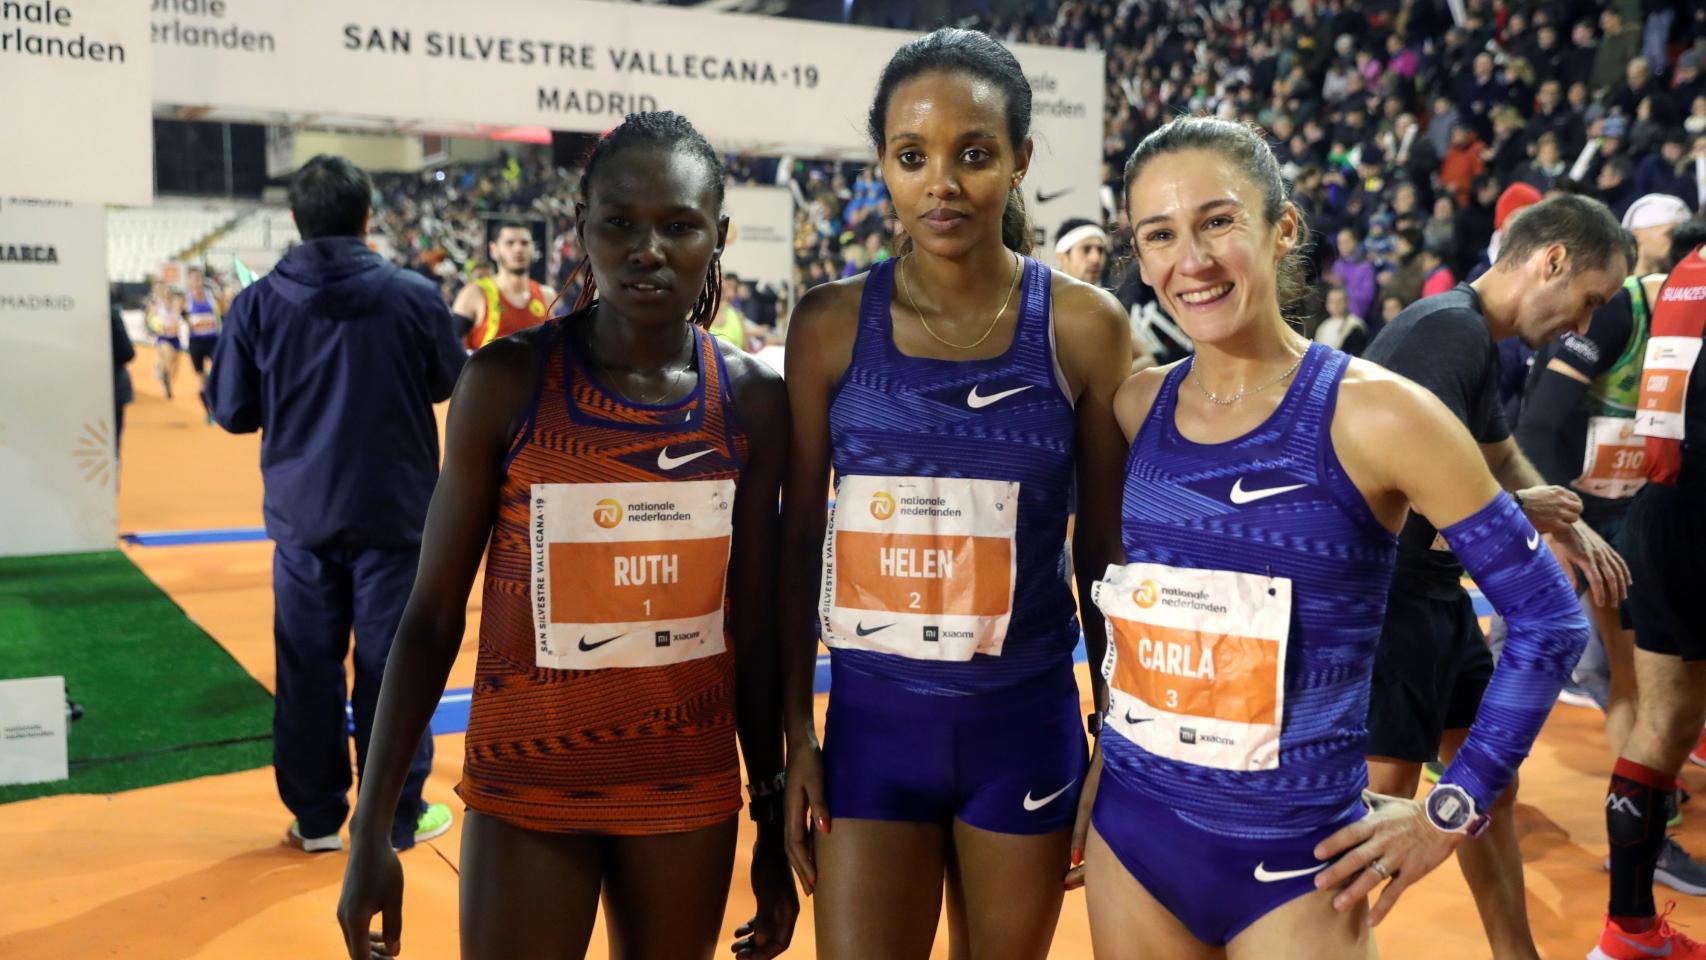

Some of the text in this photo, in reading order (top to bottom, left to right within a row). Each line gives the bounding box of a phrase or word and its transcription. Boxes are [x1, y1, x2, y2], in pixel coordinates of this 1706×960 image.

[343, 25, 411, 54] SAN
[426, 33, 597, 70] SILVESTRE
[537, 88, 658, 115] MADRID
[0, 245, 58, 263] ARCA
[628, 501, 675, 512] nationale
[900, 496, 946, 506] nationale
[628, 511, 691, 522] nederlanden
[900, 506, 962, 517] nederlanden
[614, 554, 679, 587] RUTH
[880, 547, 953, 579] HELEN
[823, 562, 833, 613] SILVESTRE
[1161, 586, 1210, 600] nationale
[536, 577, 546, 629] SILVESTRE
[643, 599, 651, 616] 1
[908, 592, 921, 608] 2
[1161, 597, 1228, 614] nederlanden
[824, 615, 833, 633] SAN
[540, 633, 548, 652] SAN
[942, 630, 974, 640] xiaomi
[1138, 637, 1216, 681] CARLA
[1165, 689, 1178, 708] 3
